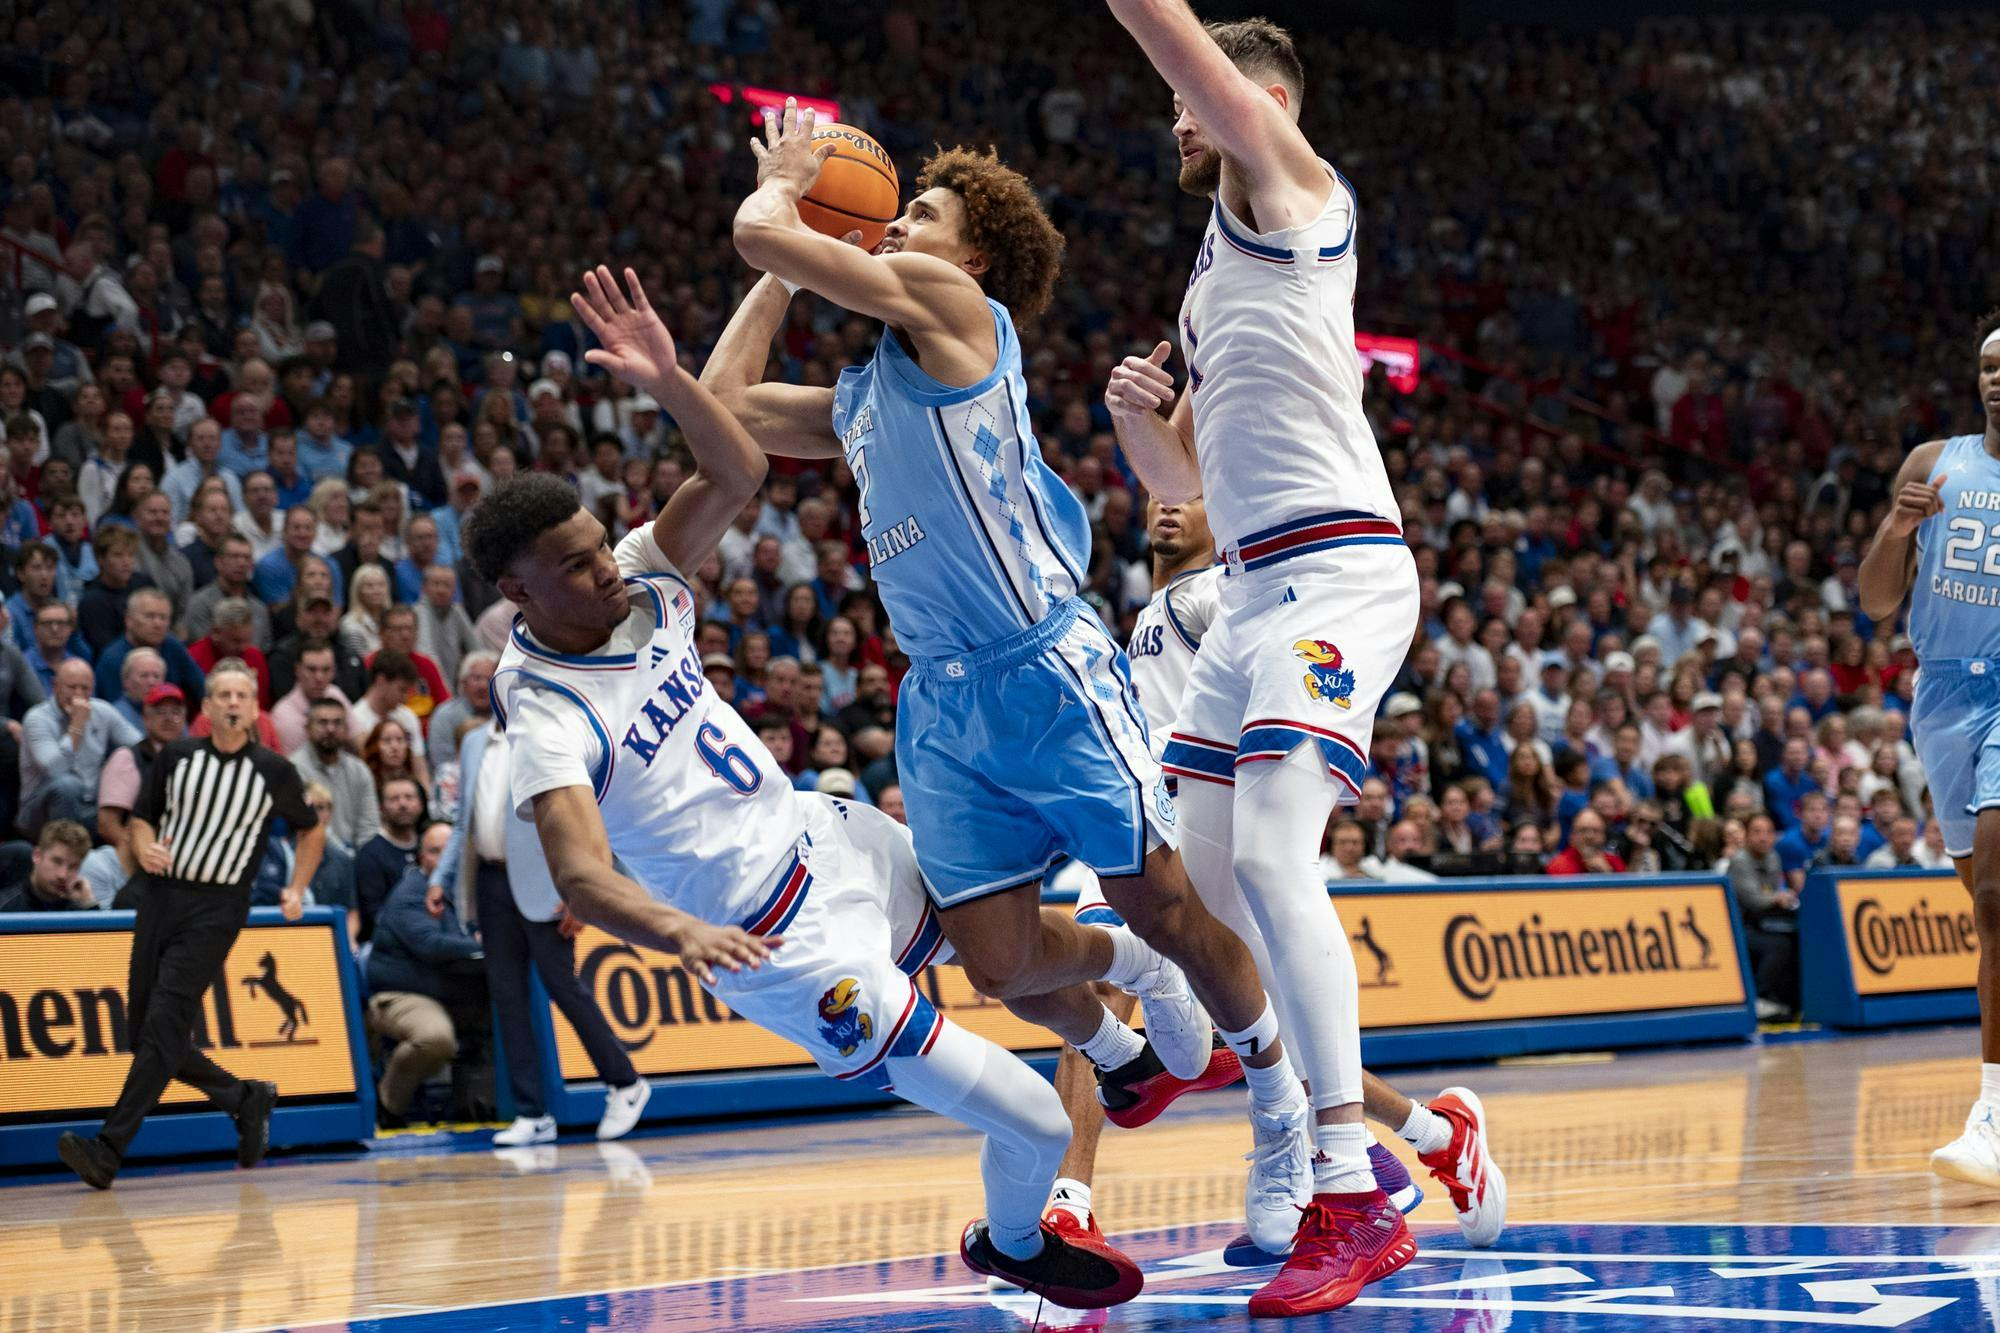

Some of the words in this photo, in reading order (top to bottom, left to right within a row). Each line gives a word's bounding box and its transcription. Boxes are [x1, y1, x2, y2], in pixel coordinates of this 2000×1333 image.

[1932, 575, 2000, 608] CAROLI
[1324, 673, 1343, 689] KU
[694, 718, 764, 797] 6
[1443, 910, 1682, 1001] Continental
[1236, 1036, 1259, 1056] 7
